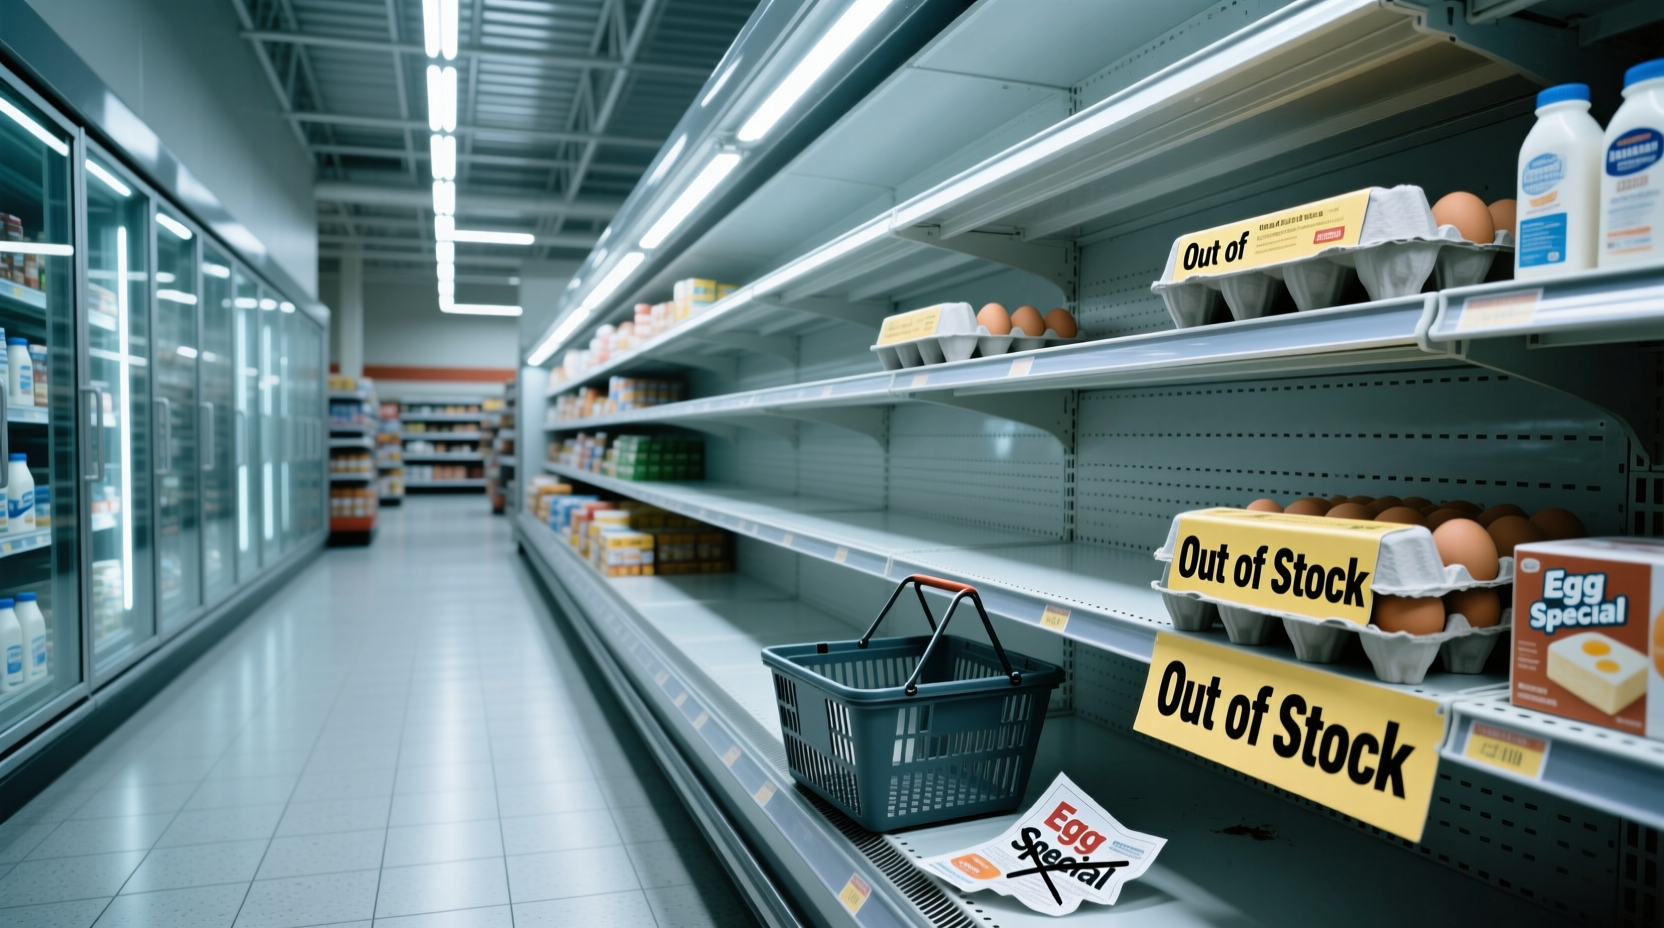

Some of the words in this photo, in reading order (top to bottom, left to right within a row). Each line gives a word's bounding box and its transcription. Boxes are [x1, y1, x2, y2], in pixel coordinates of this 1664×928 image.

[1183, 240, 1221, 271] Out
[1225, 231, 1250, 263] of
[1179, 535, 1229, 584] Out
[1234, 545, 1268, 589] of
[1271, 547, 1370, 608] Stock
[1544, 569, 1605, 606] Egg
[1530, 595, 1626, 633] Special
[1157, 660, 1221, 730] Out
[1225, 685, 1274, 746] of
[1273, 694, 1415, 800] Stock
[1044, 800, 1107, 855] Egg
[1011, 826, 1116, 891] Special
